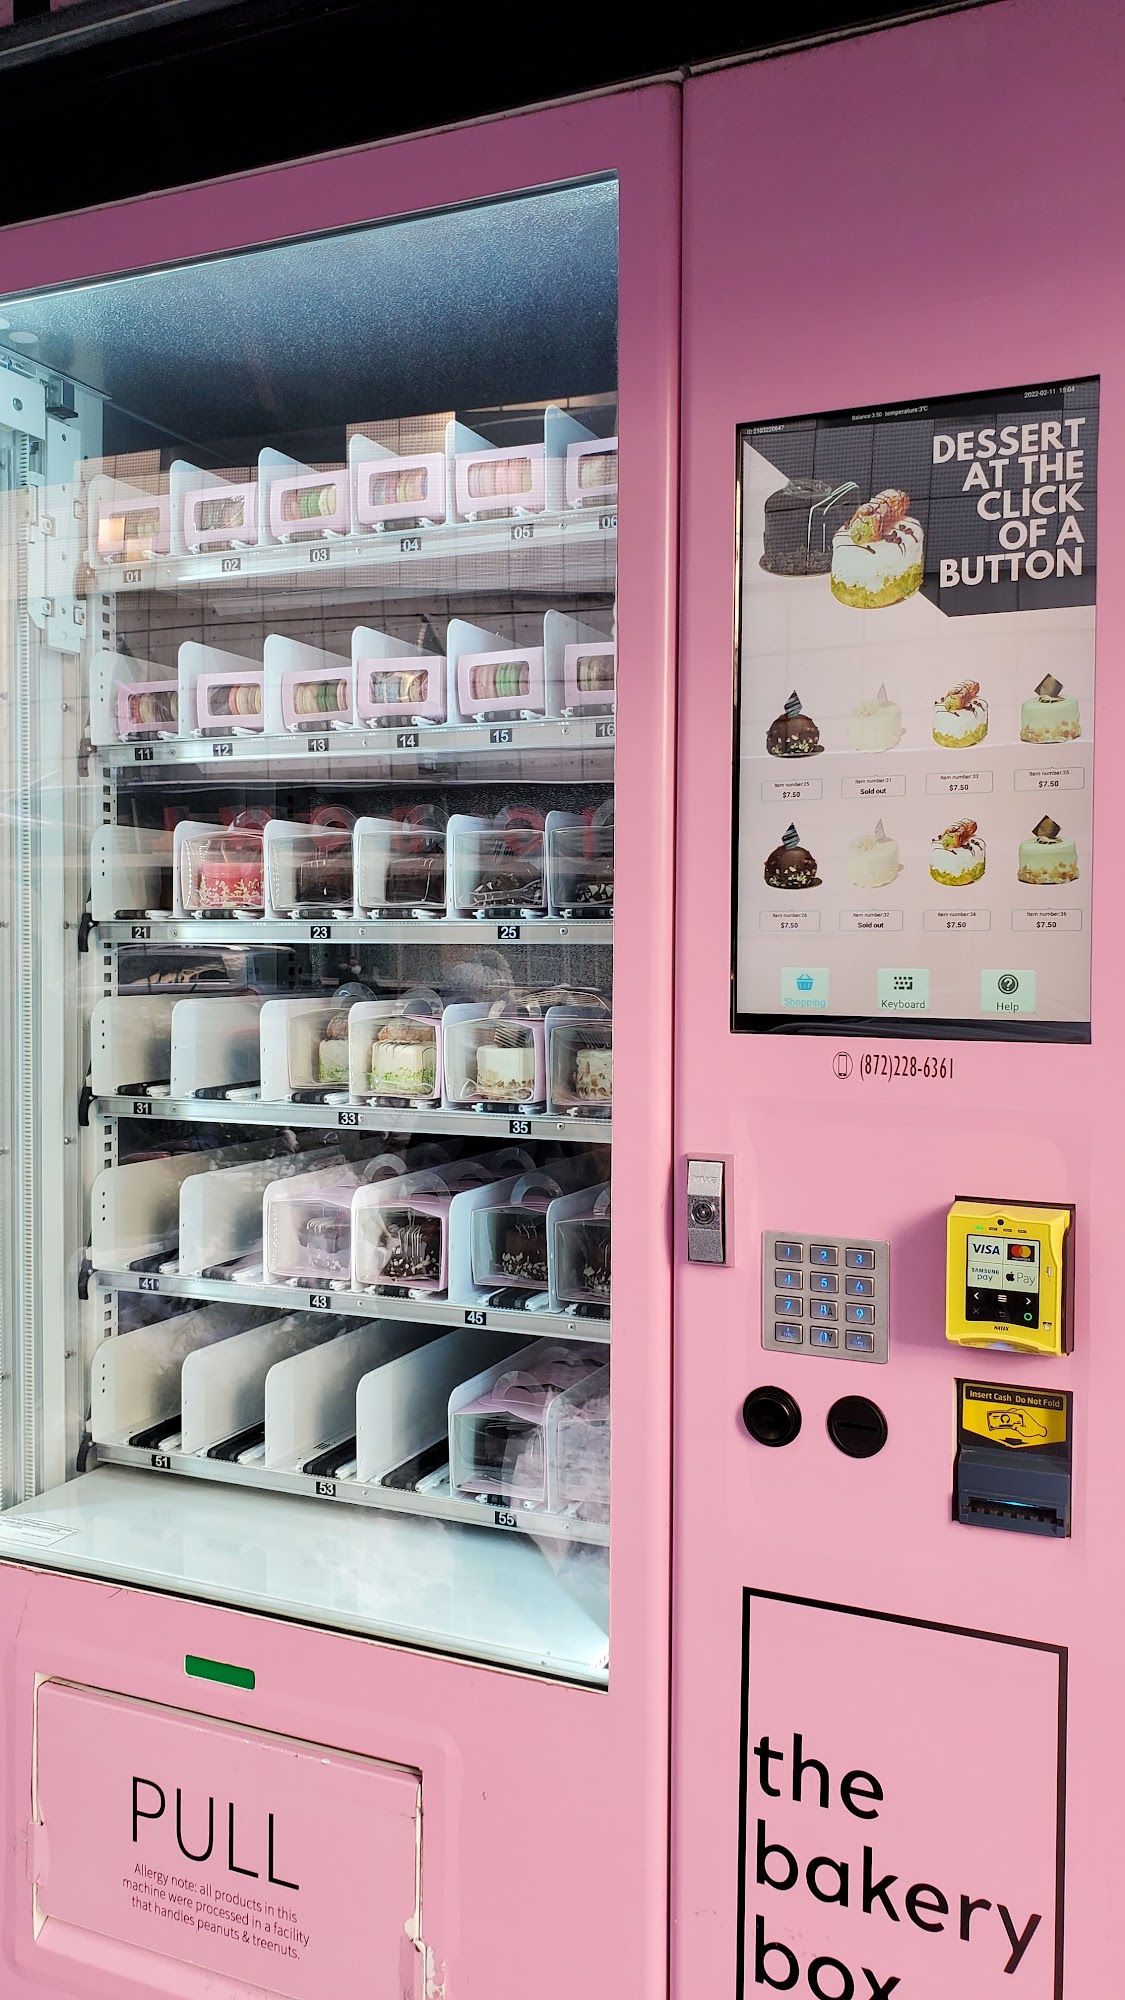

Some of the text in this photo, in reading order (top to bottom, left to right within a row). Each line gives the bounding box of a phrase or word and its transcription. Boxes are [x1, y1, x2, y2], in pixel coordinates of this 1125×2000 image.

[1024, 388, 1056, 398] 2022-02-11
[932, 418, 1086, 464] DESSERT
[962, 450, 1084, 492] AT THE
[976, 482, 1085, 521] CLICK
[602, 515, 617, 529] 06
[513, 524, 532, 539] 05
[999, 514, 1086, 551] OF A
[403, 538, 420, 552] 04
[312, 548, 329, 562] 03
[224, 558, 240, 571] 02
[939, 546, 1083, 588] BUTTON
[126, 571, 140, 583] 01
[492, 729, 510, 743] 15
[598, 723, 615, 737] 16
[310, 739, 327, 752] 13
[399, 734, 417, 748] 14
[138, 748, 151, 760] 11
[215, 744, 231, 757] 12
[1038, 780, 1059, 788] $7.50
[135, 927, 148, 938] 21
[312, 926, 329, 939] 23
[500, 926, 518, 939] 25
[784, 998, 826, 1009] Shopping
[881, 999, 926, 1010] Keyboard
[996, 1002, 1019, 1013] Help
[860, 1052, 954, 1082] (872)228-6361
[136, 1102, 149, 1114] 31
[340, 1112, 357, 1125] 33
[512, 1120, 529, 1134] 35
[972, 1243, 1000, 1255] VISA
[820, 1251, 827, 1262] 2
[856, 1254, 863, 1264] 3
[971, 1267, 1000, 1275] SAMSUNG
[977, 1274, 993, 1282] pay
[141, 1278, 155, 1290] 41
[784, 1274, 863, 1292] 4 5 6
[1016, 1272, 1036, 1286] Pay
[311, 1295, 328, 1308] 43
[785, 1301, 792, 1311] 7
[856, 1309, 864, 1318] 9
[467, 1311, 484, 1325] 45
[970, 1390, 1060, 1408] Insert Cash Do Not Fold
[155, 1455, 168, 1468] 51
[319, 1482, 335, 1495] 53
[498, 1512, 515, 1526] 55
[754, 1732, 884, 1820] the
[132, 1776, 300, 1891] PULL
[134, 1863, 298, 1924] Allergy note: all products in this
[756, 1818, 1042, 1974] bakery
[123, 1878, 310, 1948] machine were processed in a facility
[132, 1896, 300, 1960] that handles peanuts & treenuts.
[755, 1913, 902, 2000] box
